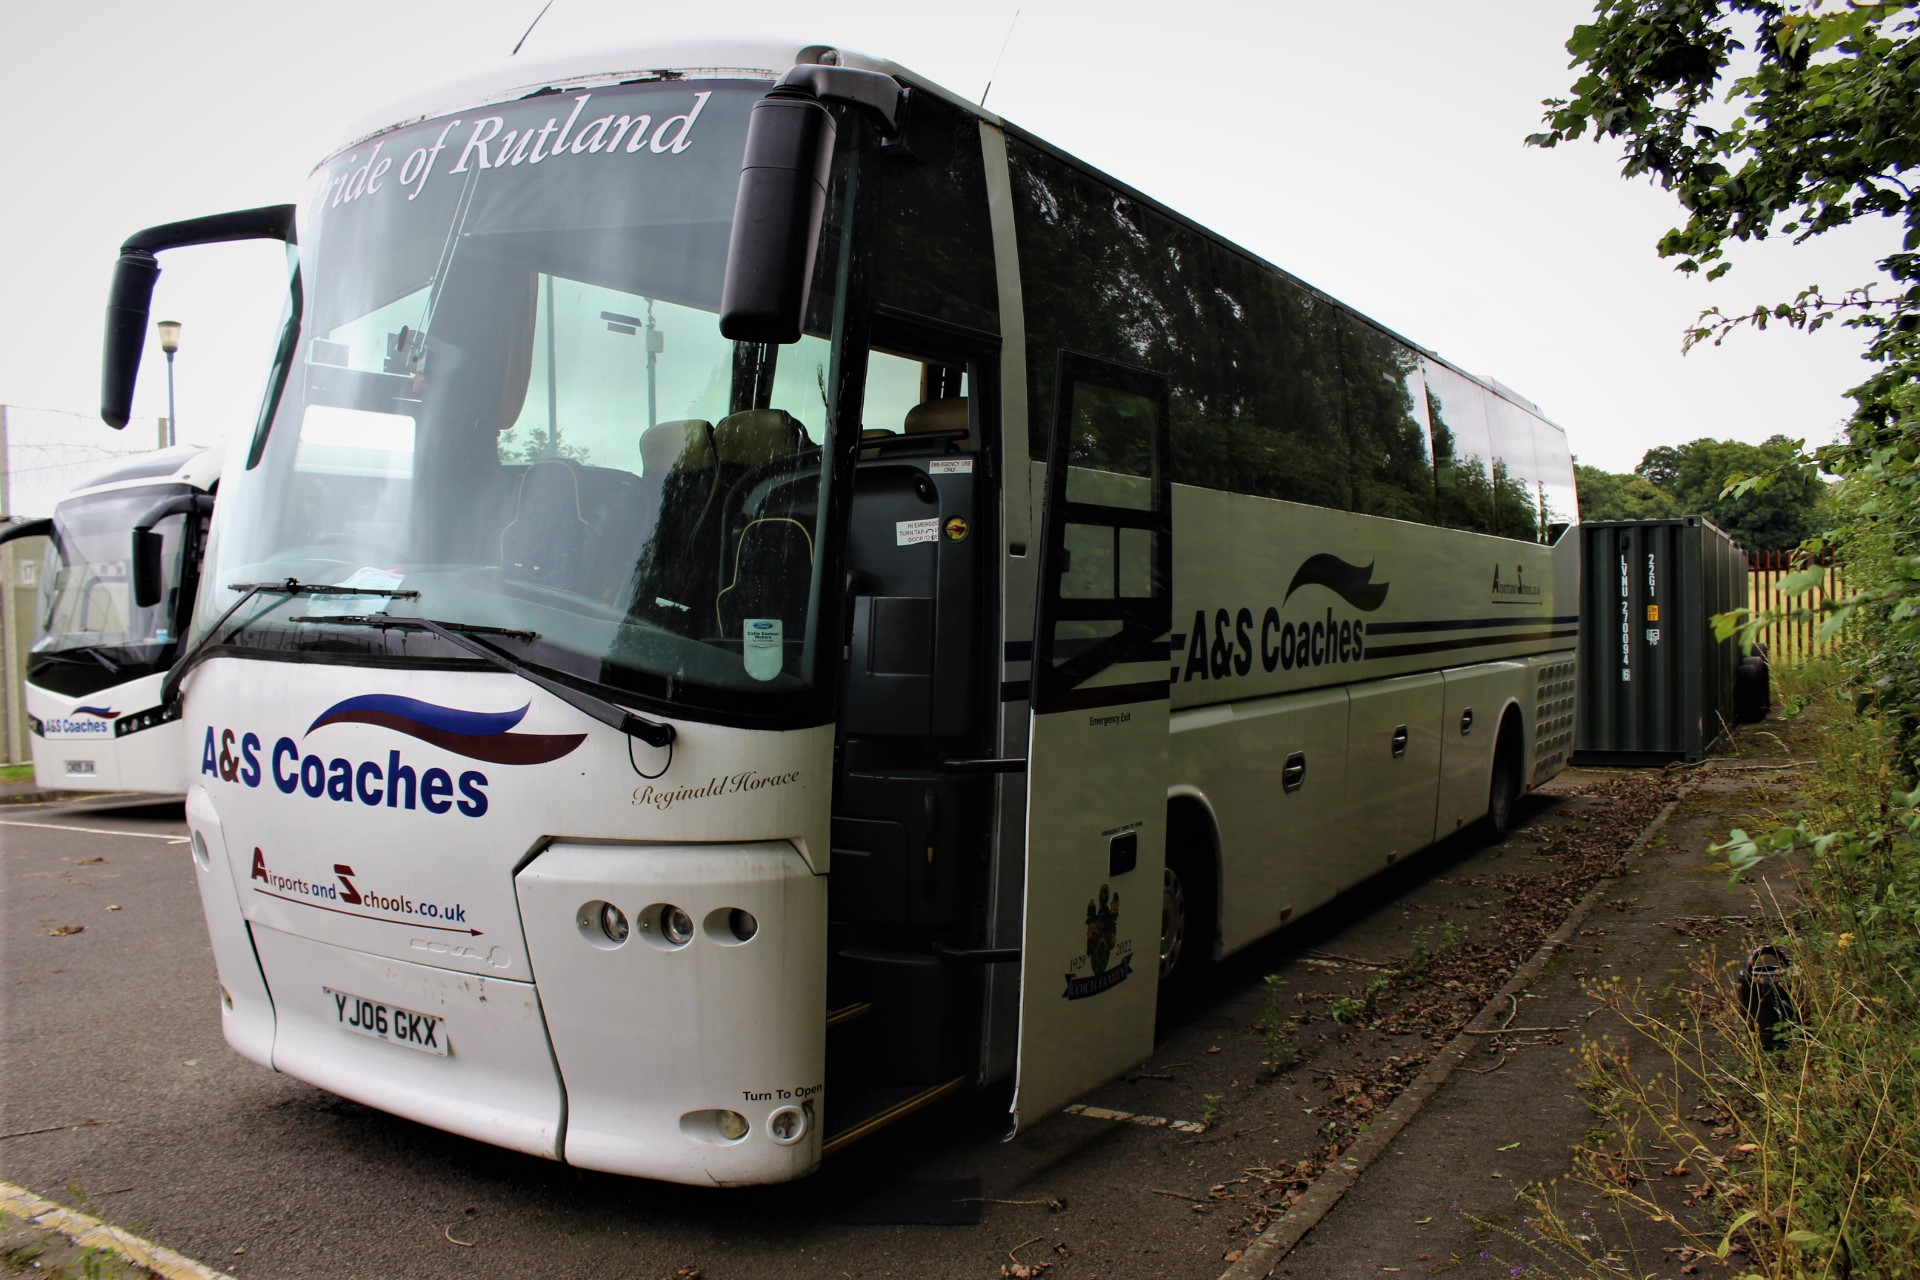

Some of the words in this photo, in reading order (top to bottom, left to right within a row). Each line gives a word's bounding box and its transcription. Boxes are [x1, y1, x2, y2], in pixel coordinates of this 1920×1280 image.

[399, 120, 461, 201] of
[449, 91, 713, 175] Rutland
[1184, 607, 1254, 684] A&S
[1261, 606, 1364, 673] Coaches
[45, 719, 61, 733] A&S
[63, 718, 107, 733] Coaches
[1090, 716, 1120, 726] Emergency
[1120, 712, 1131, 722] Exit
[201, 726, 262, 788] A&S
[272, 737, 489, 818] Coaches
[631, 776, 729, 811] Reginald
[729, 770, 800, 793] Horace
[1070, 955, 1087, 973] 1929
[1115, 940, 1133, 957] 2022
[1070, 979, 1097, 996] COACH
[335, 994, 388, 1034] YJ06
[394, 1010, 437, 1048] GKX
[743, 1091, 772, 1101] Turn
[776, 1089, 791, 1100] To
[795, 1084, 822, 1099] Open
